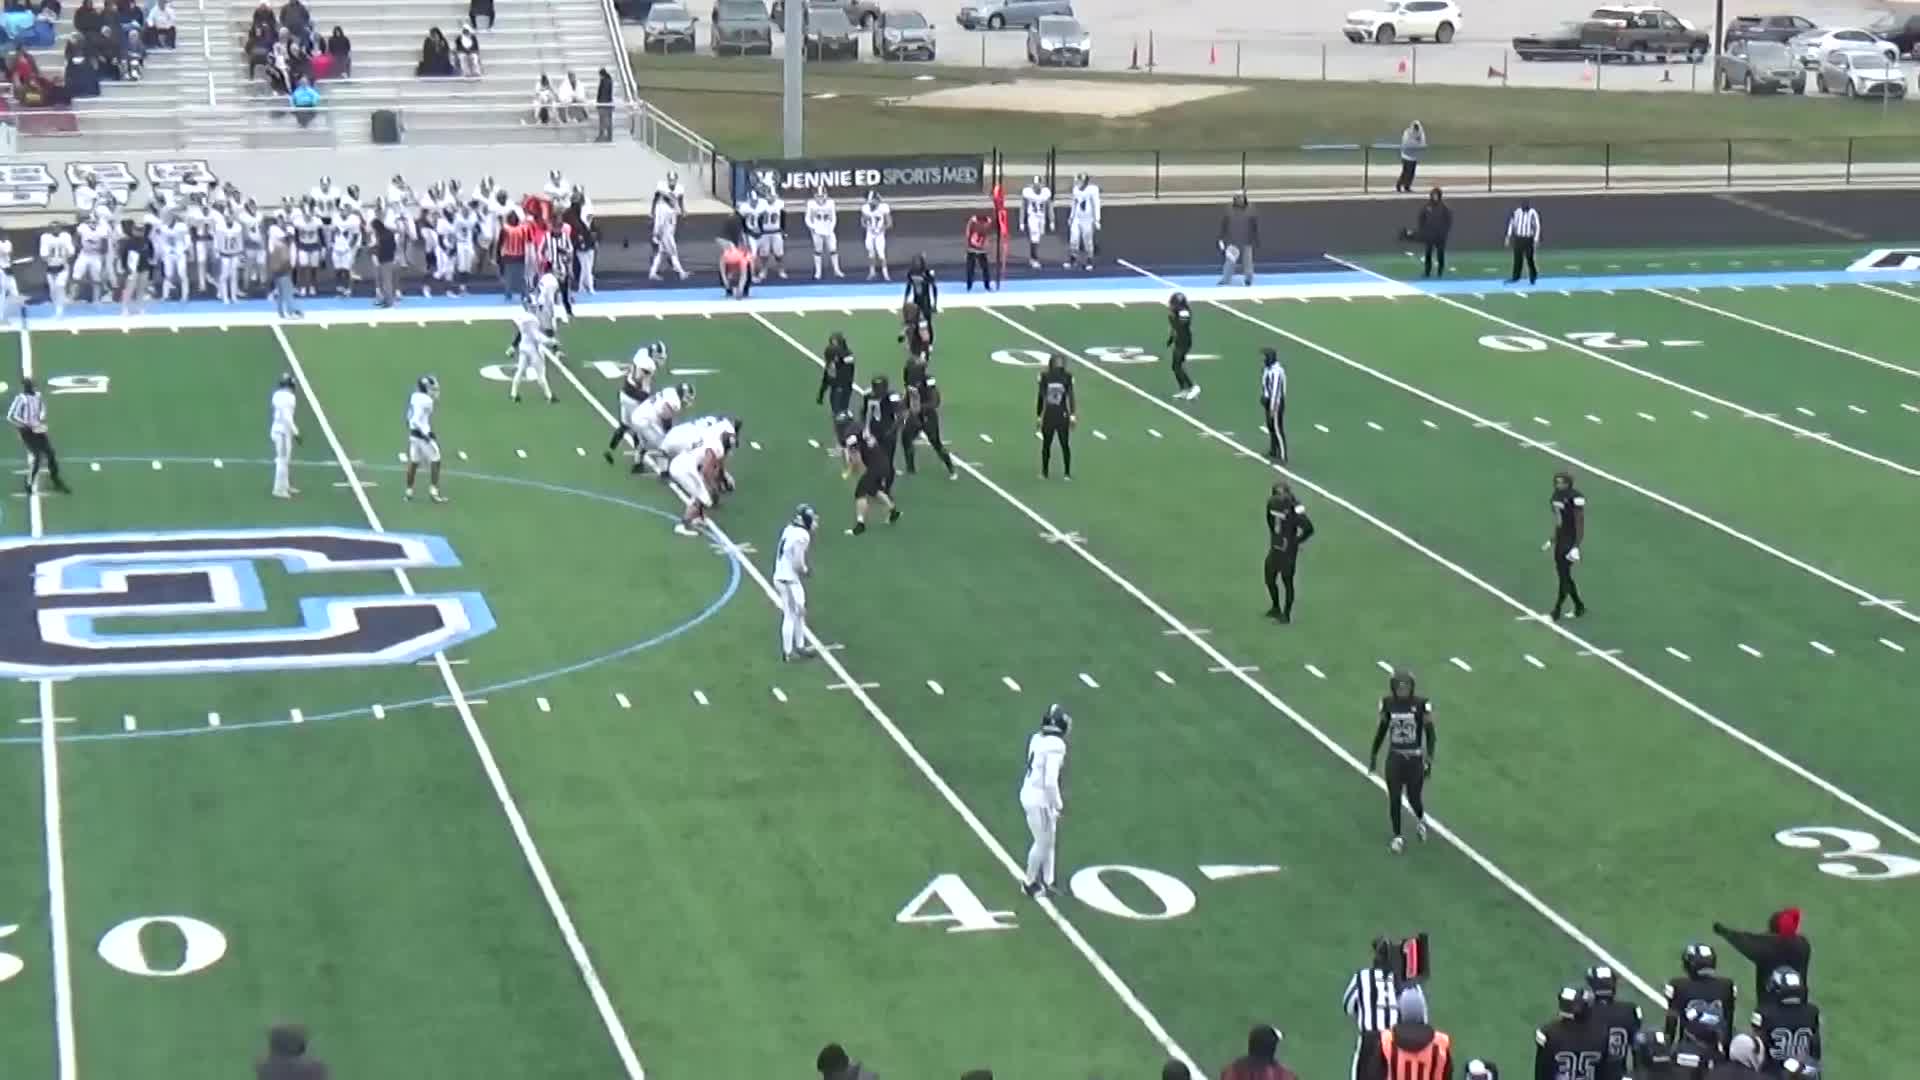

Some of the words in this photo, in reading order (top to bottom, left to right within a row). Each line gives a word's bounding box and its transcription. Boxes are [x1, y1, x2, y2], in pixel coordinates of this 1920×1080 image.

[781, 170, 853, 190] JENNIE
[854, 169, 881, 187] ED
[883, 168, 941, 185] SPORTS
[942, 166, 978, 184] MED
[1403, 938, 1419, 980] 1
